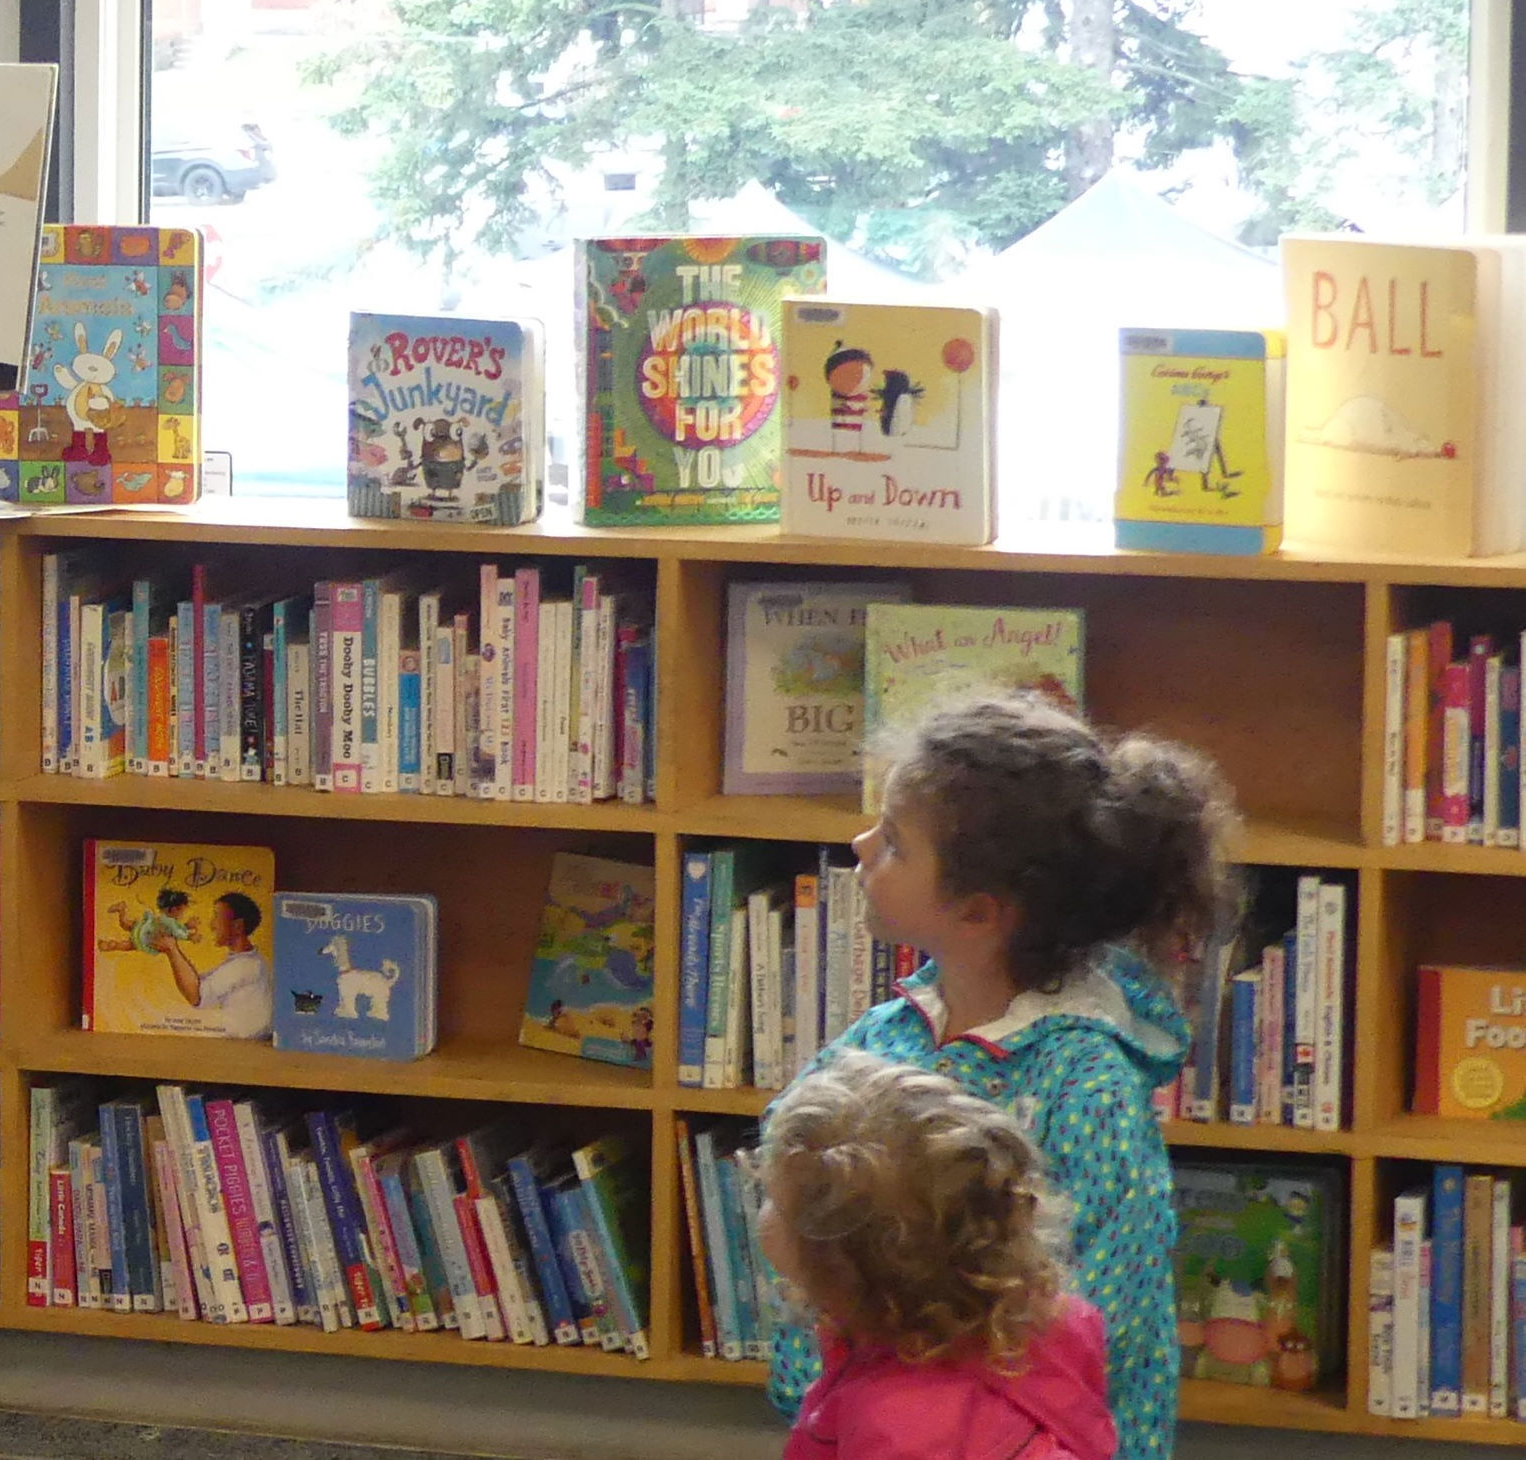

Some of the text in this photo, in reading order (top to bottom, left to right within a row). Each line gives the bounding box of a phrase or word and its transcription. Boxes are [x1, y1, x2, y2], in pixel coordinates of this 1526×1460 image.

[677, 265, 743, 302] THE
[647, 307, 773, 352] WORLD
[1312, 271, 1442, 358] BALL
[385, 332, 506, 380] ROVER'S
[642, 353, 777, 400] SHINES
[361, 367, 513, 427] Junkyard
[675, 401, 744, 442] FOR
[673, 447, 746, 489] YOU
[807, 473, 842, 513] Up
[881, 474, 962, 510] Down
[500, 618, 510, 641] Baby
[884, 629, 944, 663] What
[501, 647, 510, 685] Animals
[341, 637, 354, 759] Dooby Dooby Moo
[362, 658, 375, 718] BUBBLES
[501, 690, 510, 713] First
[294, 690, 303, 735] The Hat
[785, 704, 854, 733] BIG
[500, 741, 510, 765] Book
[107, 857, 263, 888] Baby Dance
[1490, 985, 1526, 1015] Li
[1464, 1018, 1526, 1049] Foo
[210, 1108, 235, 1160] POCKET
[222, 1162, 246, 1215] PIGGIES
[56, 1203, 66, 1235] Canada
